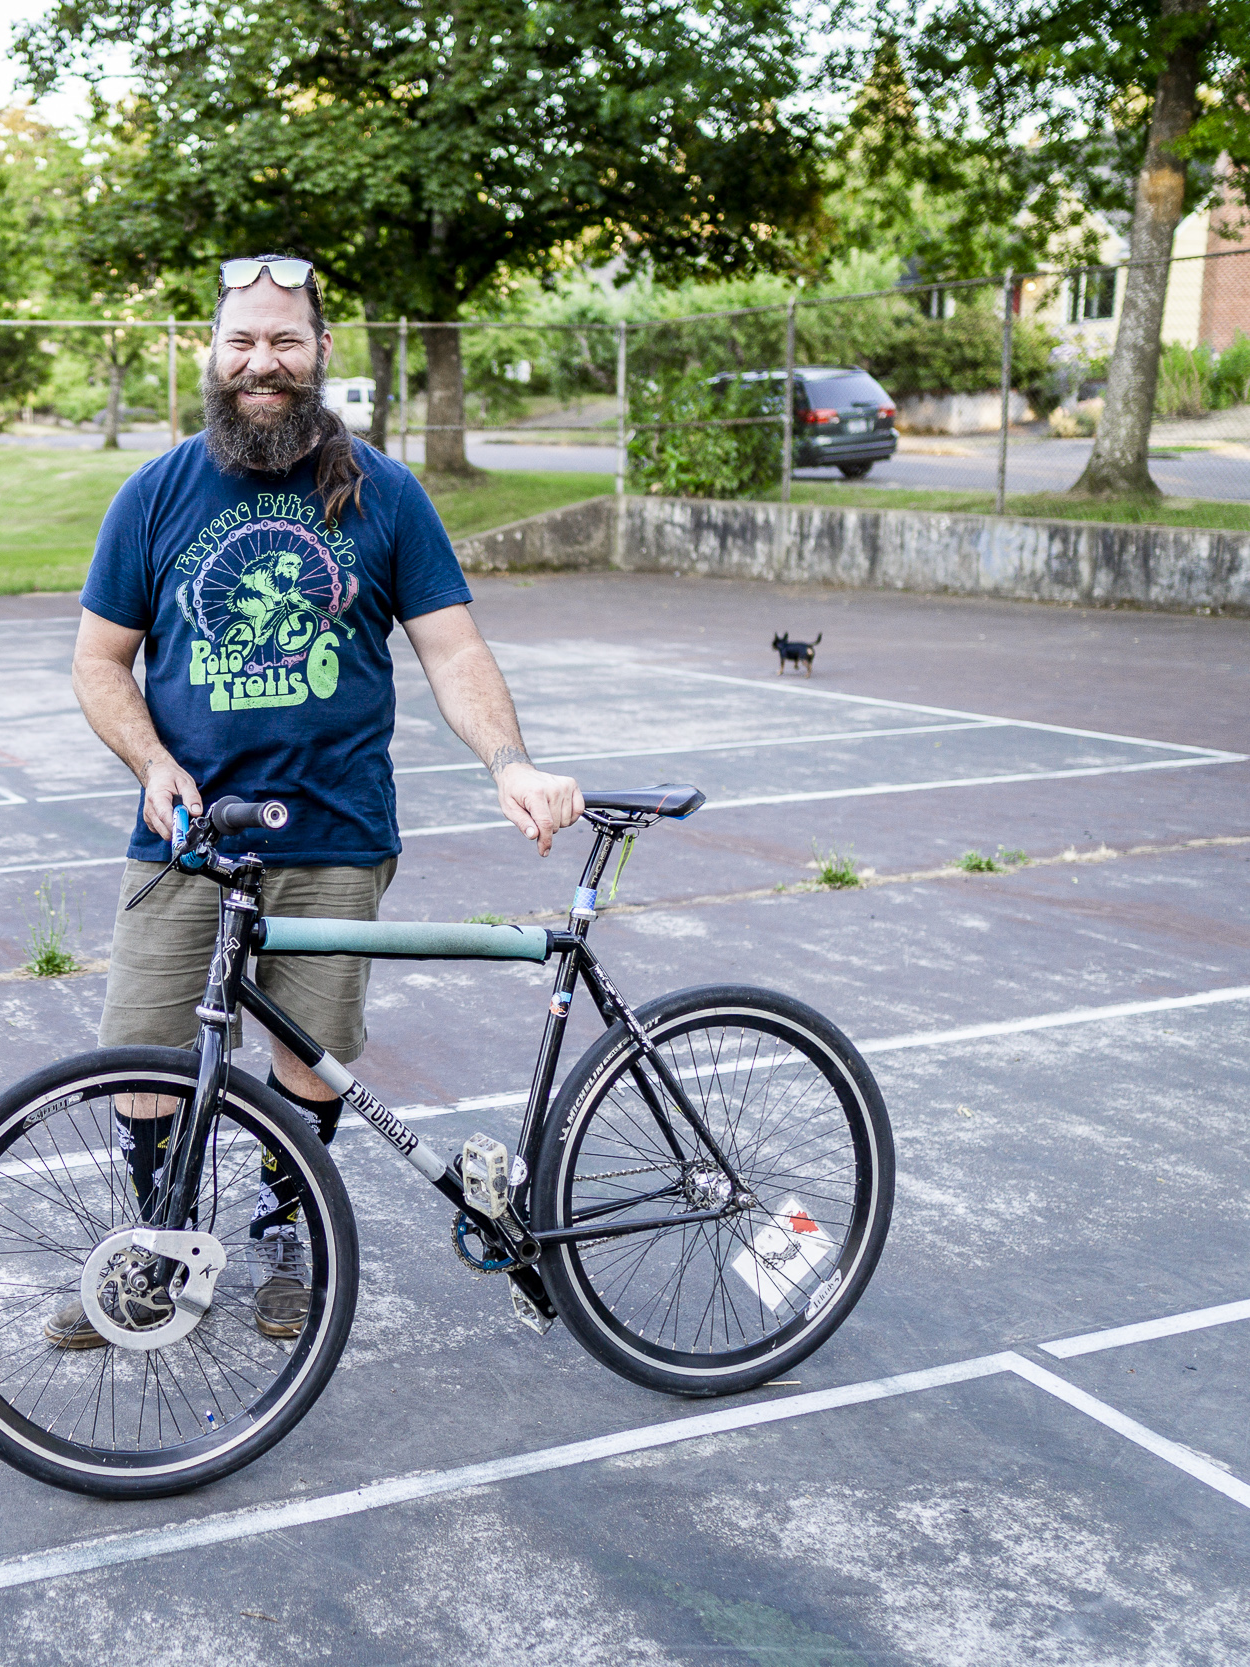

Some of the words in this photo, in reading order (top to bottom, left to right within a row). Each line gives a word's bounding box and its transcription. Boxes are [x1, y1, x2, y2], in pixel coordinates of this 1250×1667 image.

[175, 501, 252, 575] Eugene
[257, 493, 316, 525] Bike
[312, 517, 356, 568] Polo
[189, 640, 244, 686] Polo
[206, 667, 309, 712] Trolls
[306, 631, 341, 700] 6
[590, 835, 612, 885] THOMSON
[340, 1079, 420, 1157] ENFORCER
[566, 1062, 606, 1125] MICHELIN
